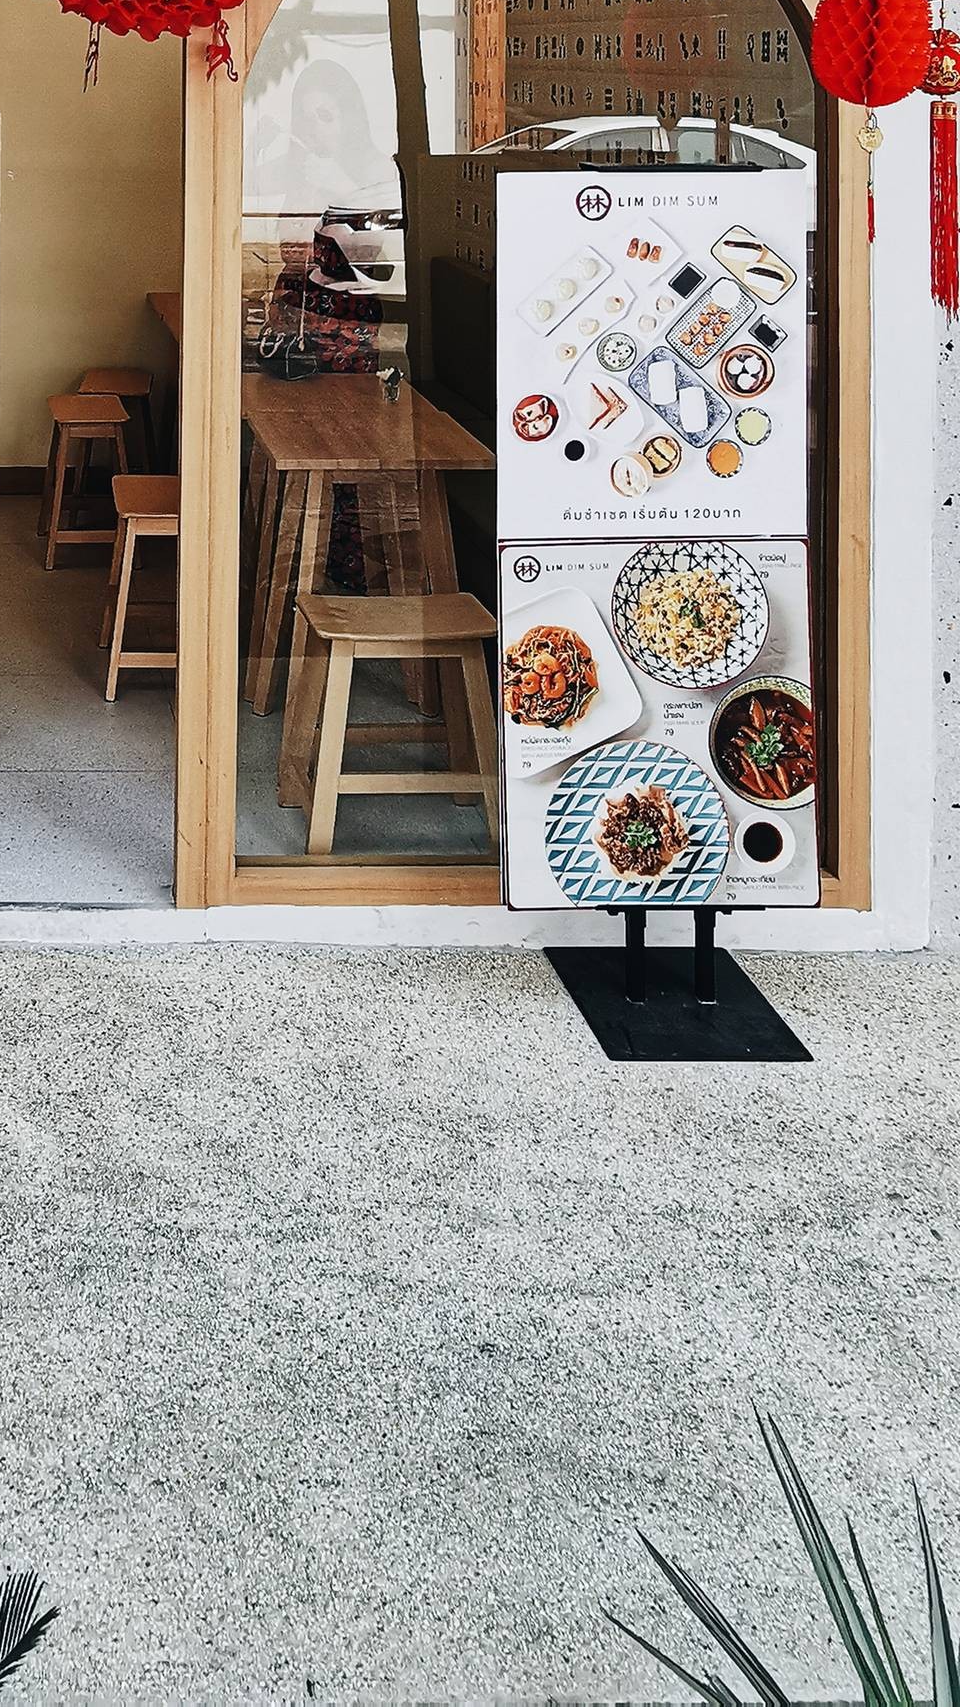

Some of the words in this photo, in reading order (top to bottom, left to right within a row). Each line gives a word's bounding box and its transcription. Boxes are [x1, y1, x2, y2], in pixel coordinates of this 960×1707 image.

[618, 196, 644, 207] LIM
[652, 195, 679, 207] DIM
[687, 195, 719, 207] SUM
[546, 564, 563, 572] LIM
[567, 563, 585, 571] DIM
[589, 562, 609, 571] SUM
